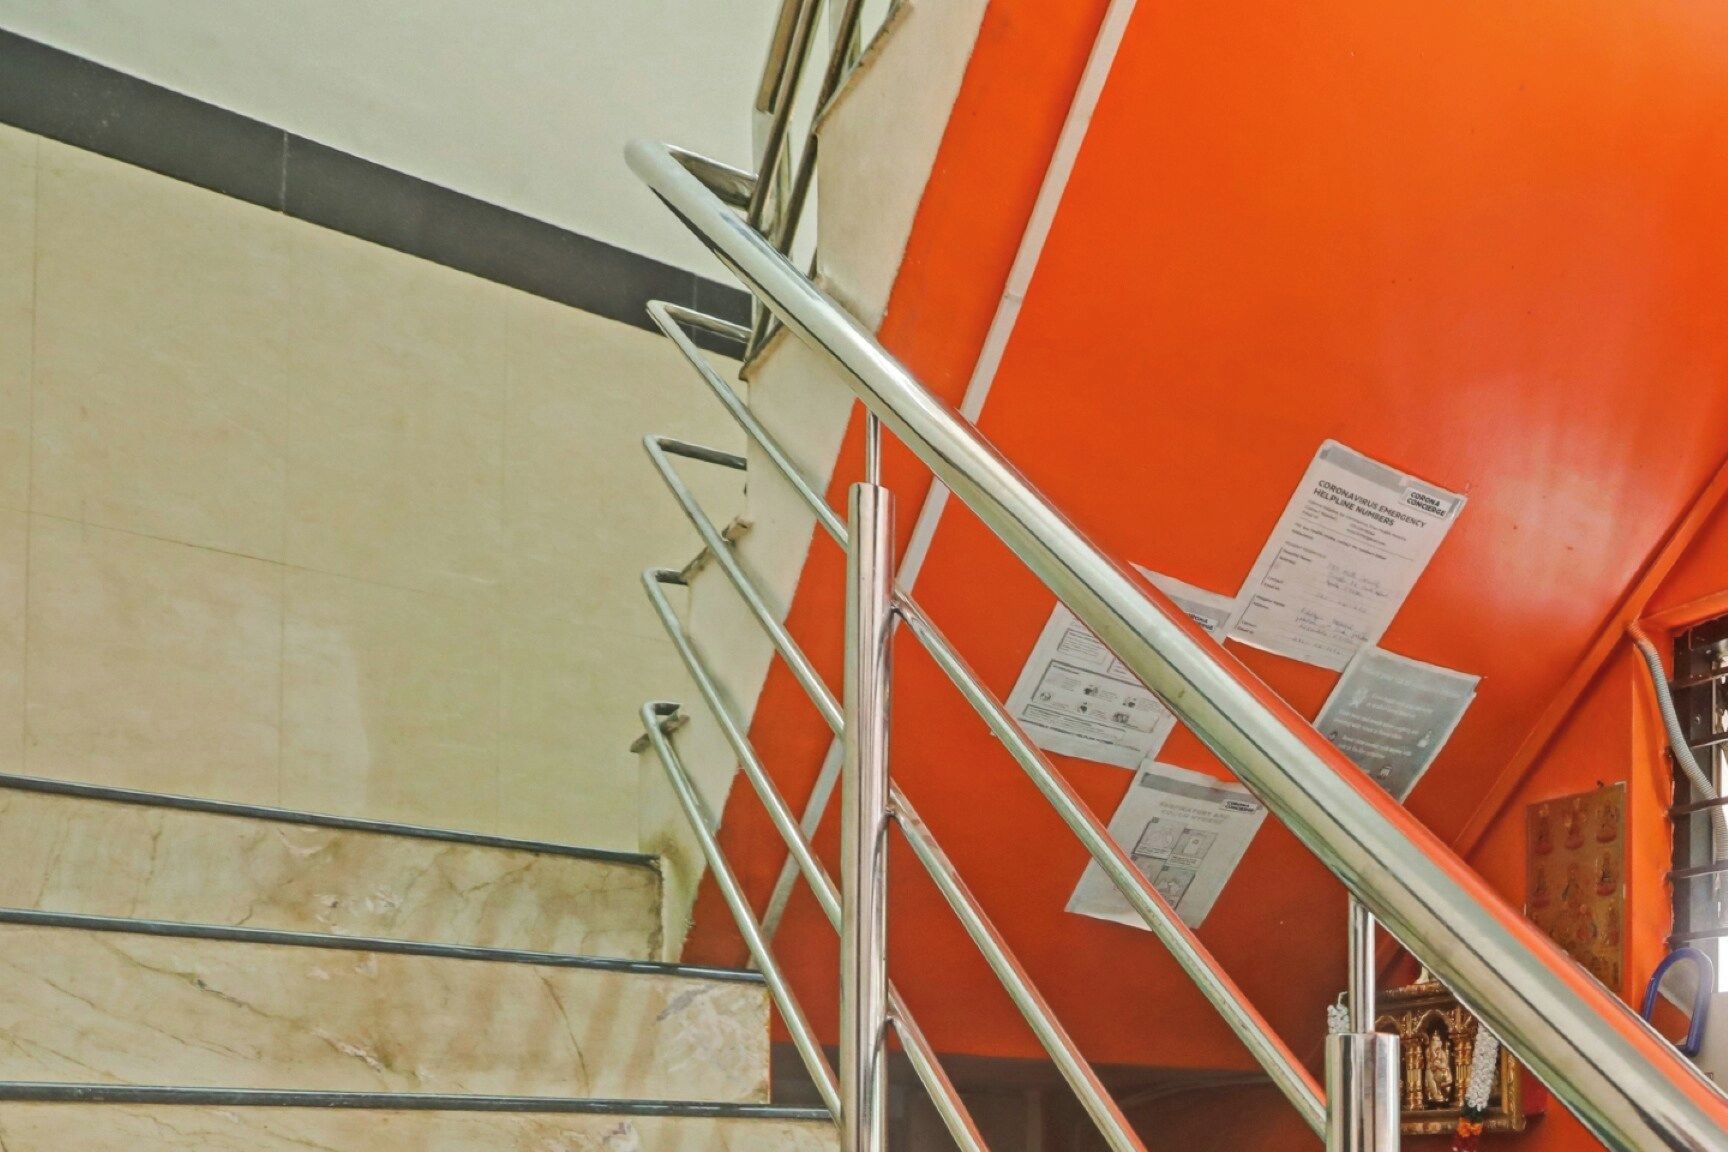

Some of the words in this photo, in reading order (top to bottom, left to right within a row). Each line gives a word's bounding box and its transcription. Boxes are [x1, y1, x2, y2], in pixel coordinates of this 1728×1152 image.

[1313, 487, 1355, 511] HELPLINE
[1355, 505, 1395, 527] NUMBERS
[1318, 480, 1378, 509] CORONAVIRUS
[1379, 505, 1427, 528] EMERGENCY
[1406, 498, 1446, 517] CONCIERGE
[1410, 491, 1440, 507] CORONA
